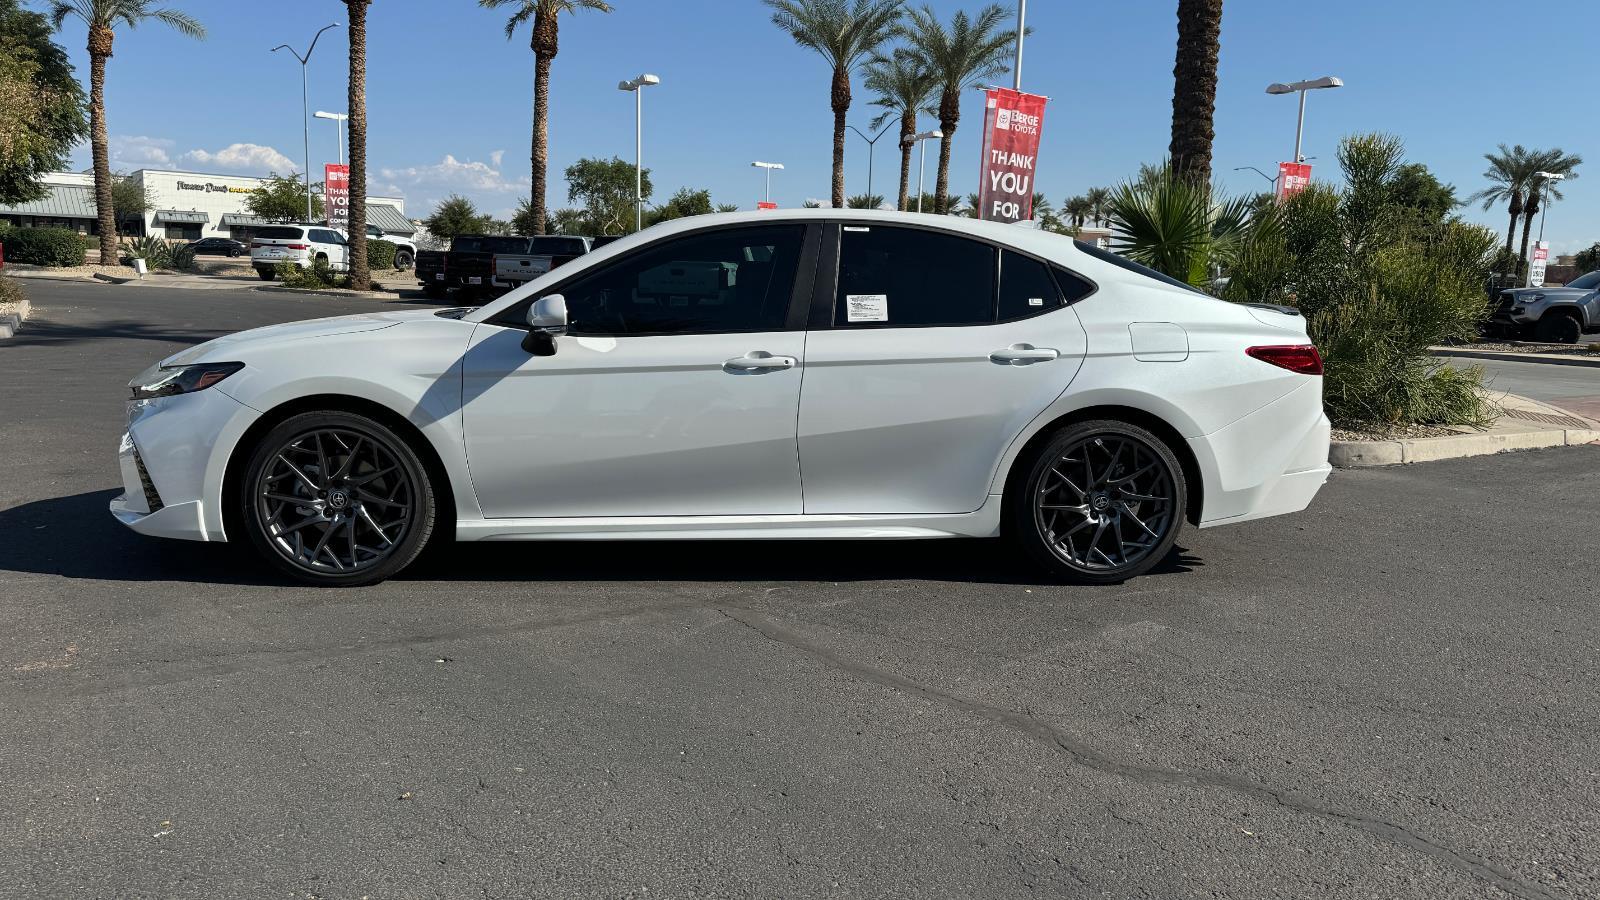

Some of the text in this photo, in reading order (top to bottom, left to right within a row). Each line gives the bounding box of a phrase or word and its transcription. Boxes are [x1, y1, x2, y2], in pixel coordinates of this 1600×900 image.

[1011, 109, 1040, 127] BERGE
[1011, 123, 1038, 136] TOYOTA
[992, 149, 1034, 170] THANK
[991, 169, 1029, 196] YOU
[993, 200, 1020, 219] FOR
